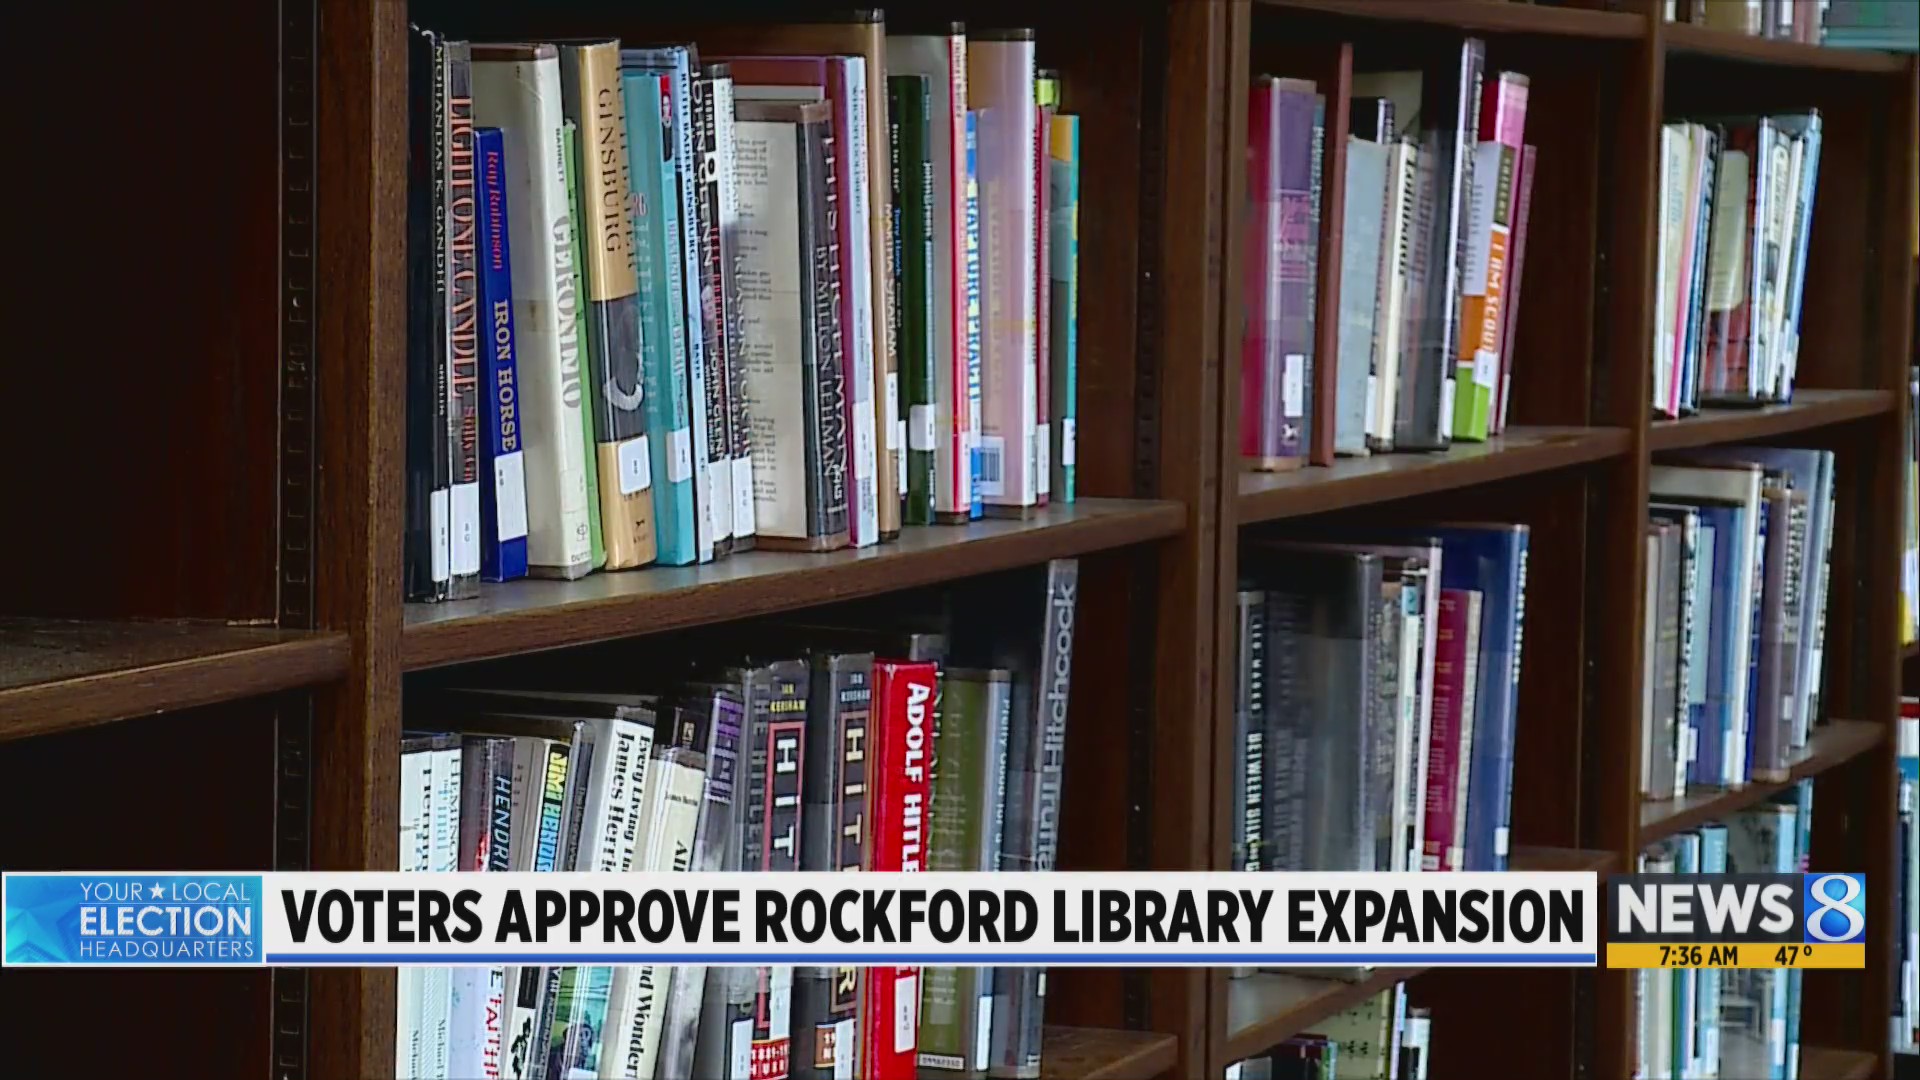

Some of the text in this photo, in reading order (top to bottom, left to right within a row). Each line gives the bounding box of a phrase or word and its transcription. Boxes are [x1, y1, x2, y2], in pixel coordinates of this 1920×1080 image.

[434, 46, 444, 169] MOHANDAS
[486, 151, 504, 270] Ray Robinson
[598, 87, 622, 253] GINSBURG
[686, 178, 697, 260] GINSBURG
[691, 70, 712, 267] JOHN GLENN
[436, 205, 445, 293] GANDHI
[552, 216, 581, 408] GERONIMO
[815, 247, 836, 477] BY MILTON LEHMAN
[494, 299, 517, 452] IRON HORSE
[709, 348, 721, 398] JOHN
[905, 682, 931, 784] ADOLF
[1043, 585, 1076, 772] Hitchcock
[449, 758, 460, 871] HEMINGW
[536, 752, 568, 871] JIMI HENDR
[610, 732, 635, 799] James
[624, 787, 643, 841] Living
[633, 735, 651, 783] Every
[491, 775, 512, 871] HENDRI
